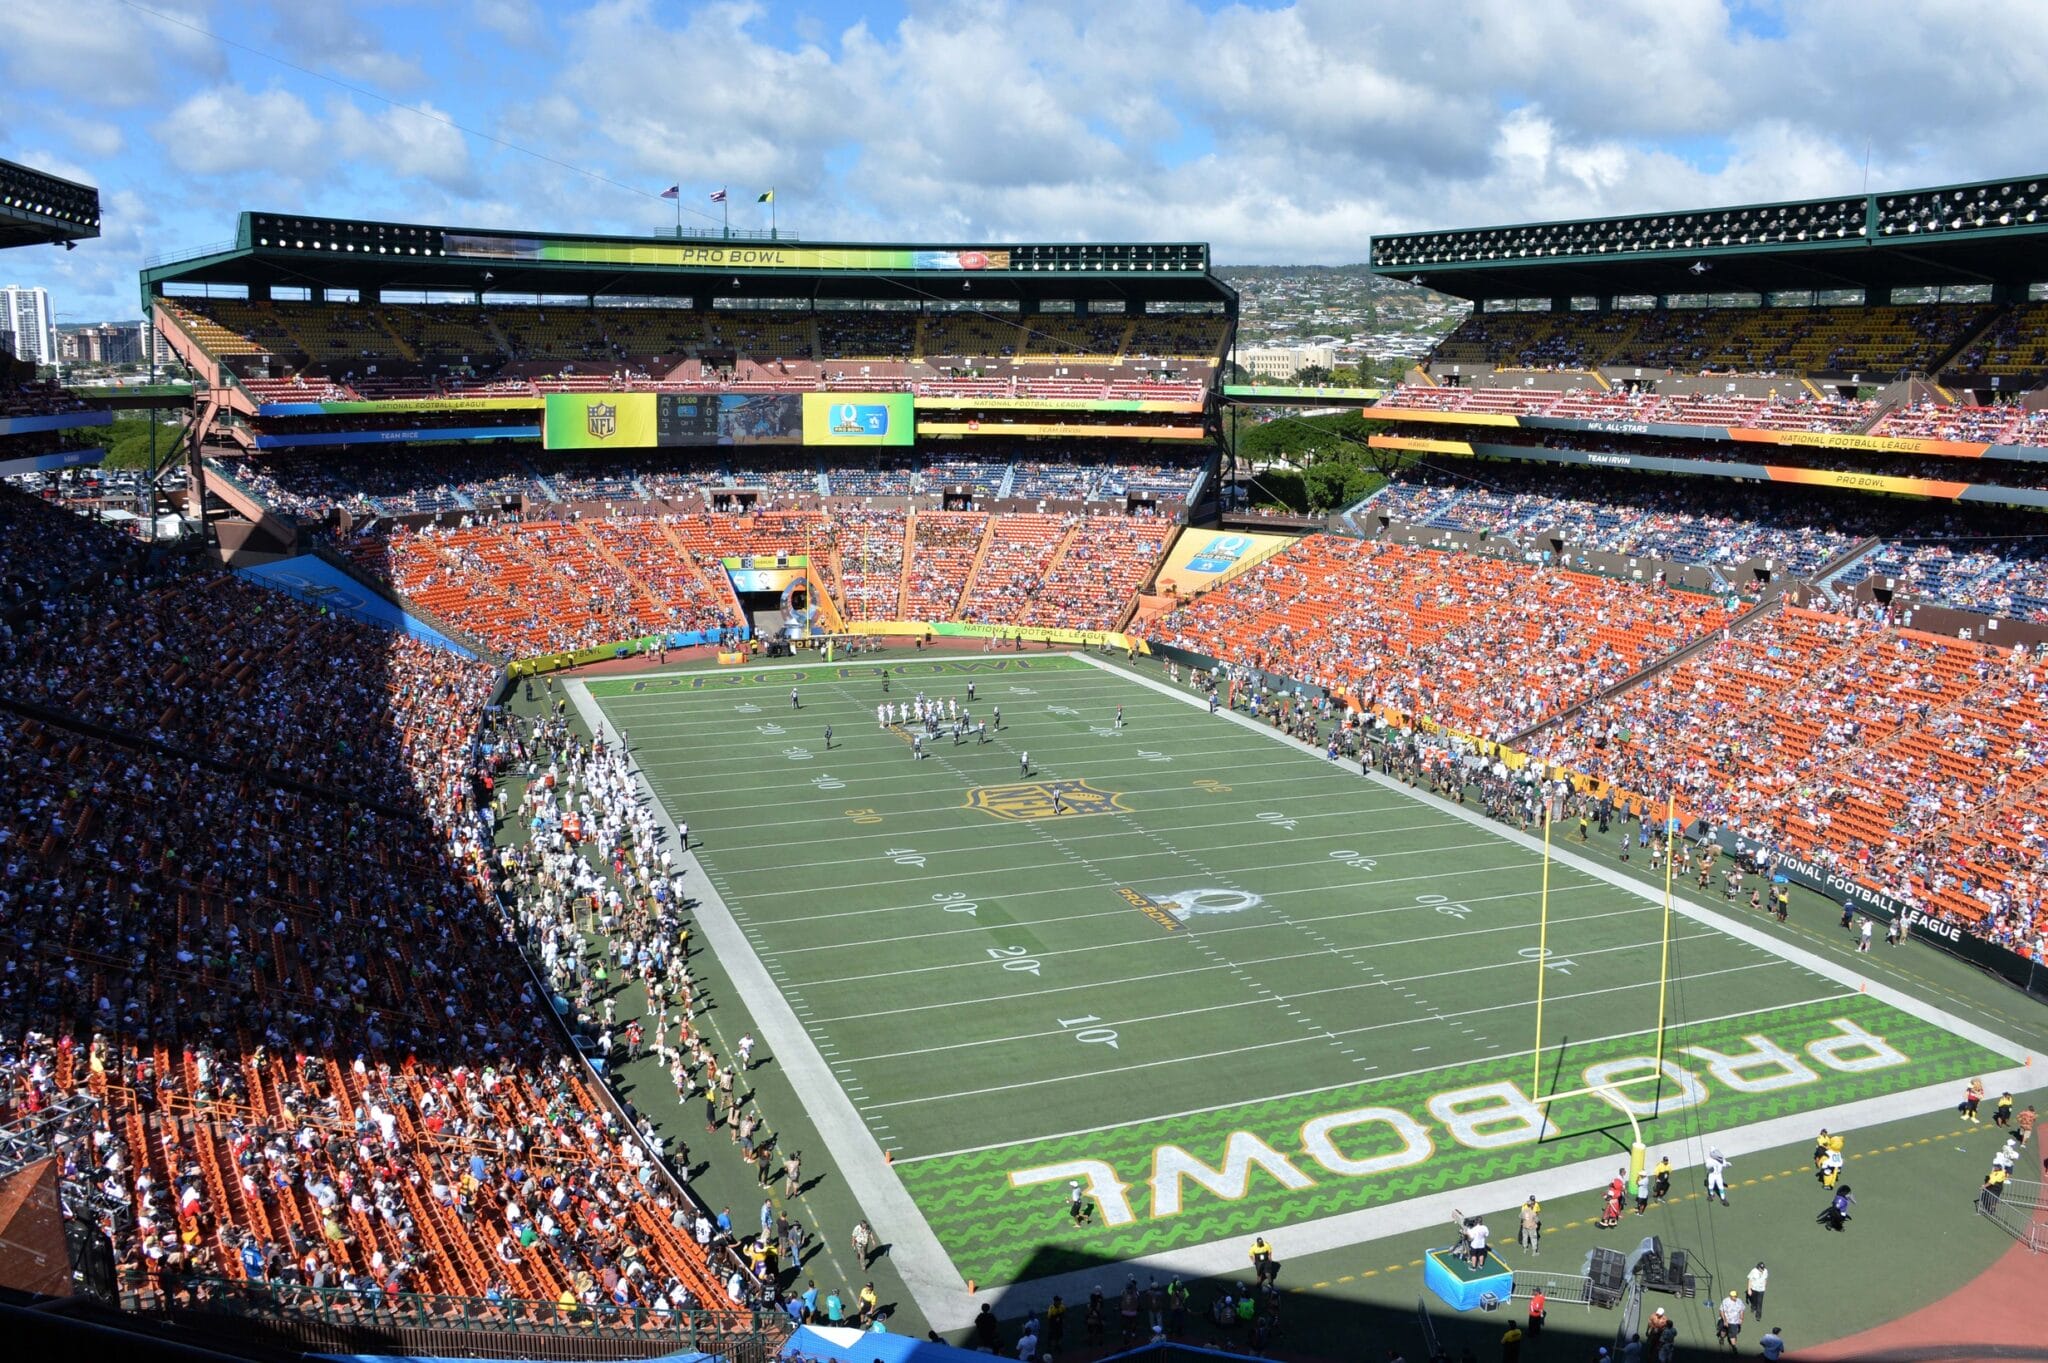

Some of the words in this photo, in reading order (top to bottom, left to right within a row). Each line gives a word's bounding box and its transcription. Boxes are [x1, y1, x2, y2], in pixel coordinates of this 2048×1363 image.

[682, 248, 724, 262] PRO
[729, 250, 785, 264] BOWL
[402, 431, 419, 439] RICE
[591, 418, 614, 435] NFL
[1588, 422, 1603, 431] NFL
[1606, 423, 1648, 433] ALL-STARS
[1780, 434, 1826, 445] NATIONAL
[1829, 437, 1878, 449] FOOTBALL
[1881, 440, 1921, 451] LEAGUE
[1588, 454, 1607, 463] TEAM
[1608, 456, 1631, 465] IRVIN
[1836, 475, 1857, 485] PRO
[1858, 477, 1885, 488] BOWL
[1015, 628, 1065, 637] FOOTBALL
[1069, 630, 1107, 640] LEAGUE
[632, 672, 809, 691] PRO
[837, 659, 1060, 680] BOWL
[1193, 779, 1233, 793] 50
[845, 808, 883, 824] 50
[1255, 811, 1299, 828] 40
[885, 848, 926, 866] 40
[1329, 850, 1378, 868] 30
[932, 892, 978, 913] 30
[1120, 887, 1145, 907] PRO
[1141, 904, 1182, 932] BOWL
[1415, 894, 1473, 914] 20
[1826, 875, 1896, 914] FOOTBALL
[1901, 906, 1962, 943] LEAGUE
[986, 946, 1041, 971] 20
[1518, 946, 1579, 971] 10
[1057, 1014, 1118, 1044] 10
[1582, 1017, 1911, 1116] PRO
[1007, 1078, 1562, 1228] BOWL
